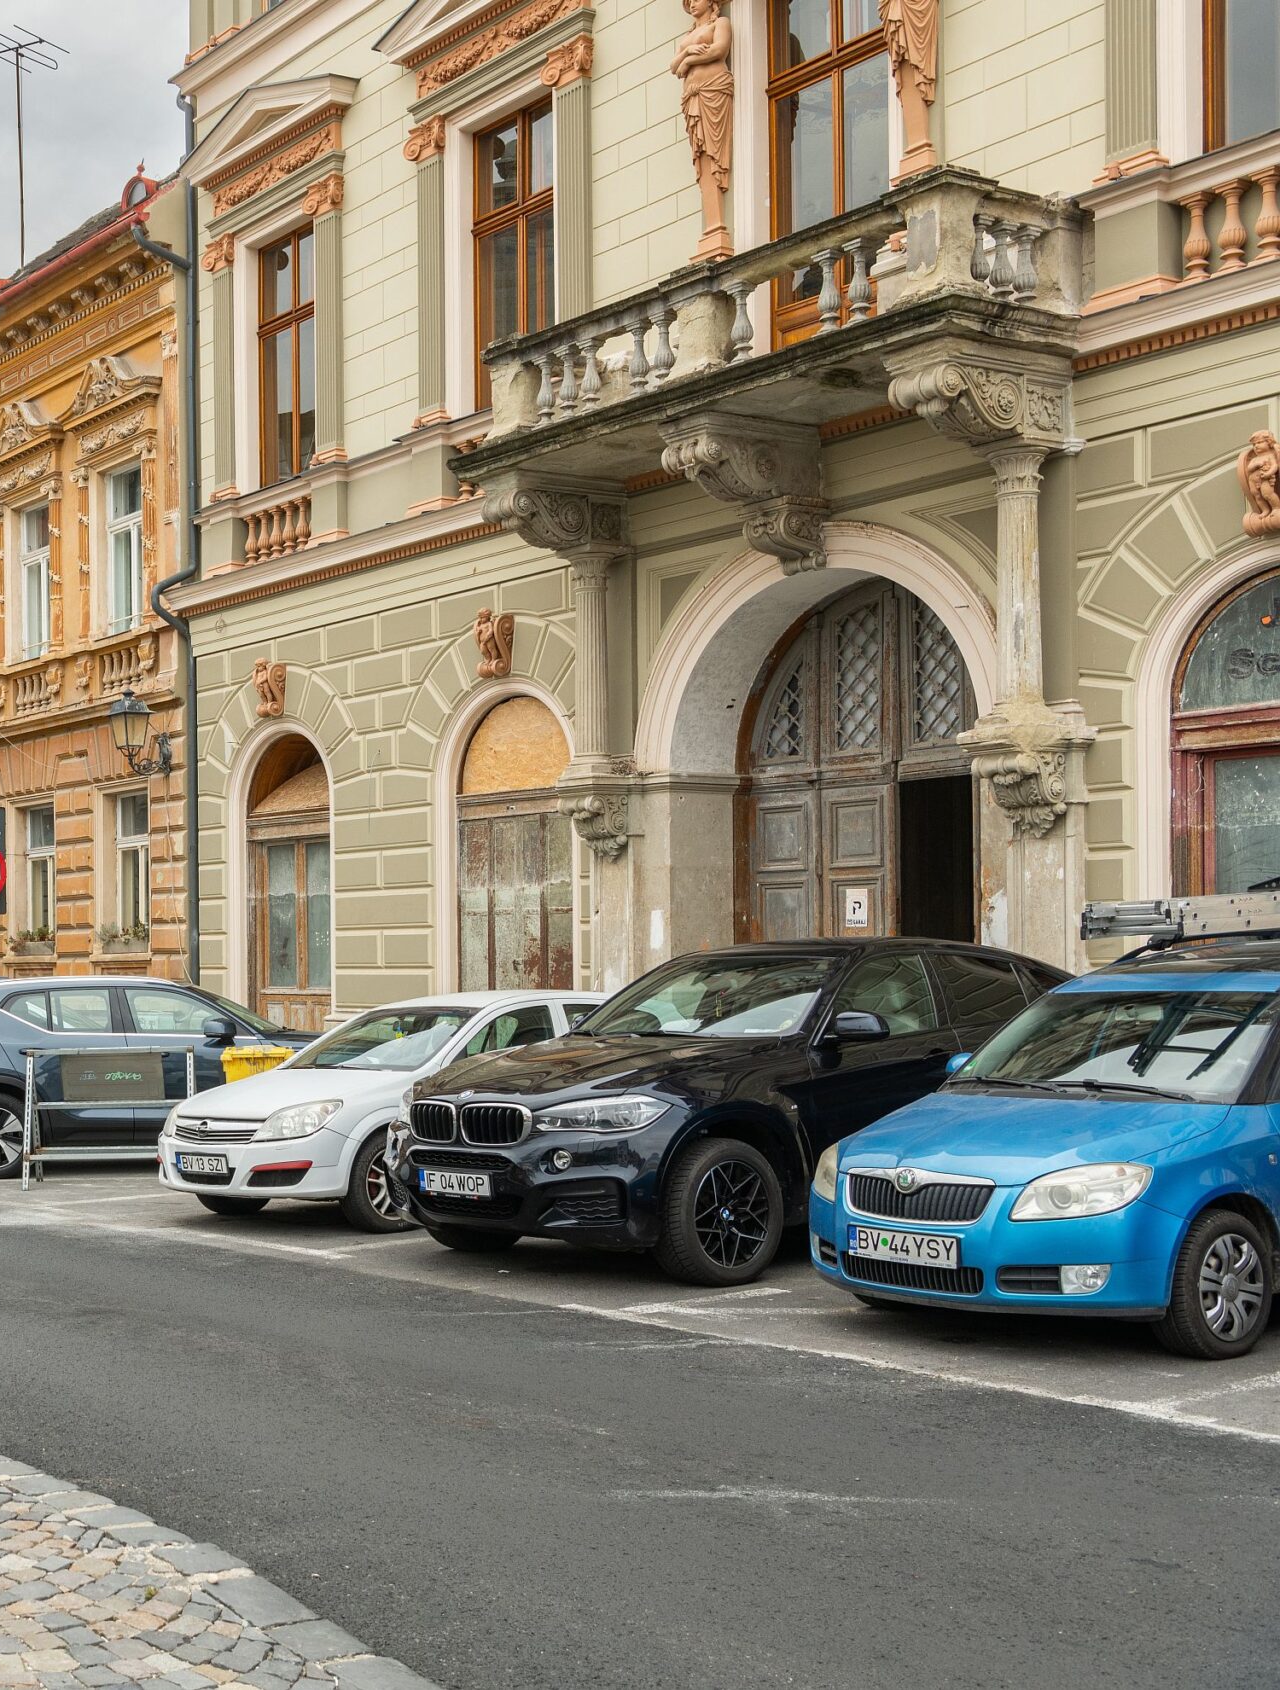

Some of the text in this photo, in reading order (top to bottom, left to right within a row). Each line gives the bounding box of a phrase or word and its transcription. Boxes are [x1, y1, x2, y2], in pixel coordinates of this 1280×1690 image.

[182, 1156, 224, 1172] BV 13 SZI
[858, 1229, 881, 1251] BV
